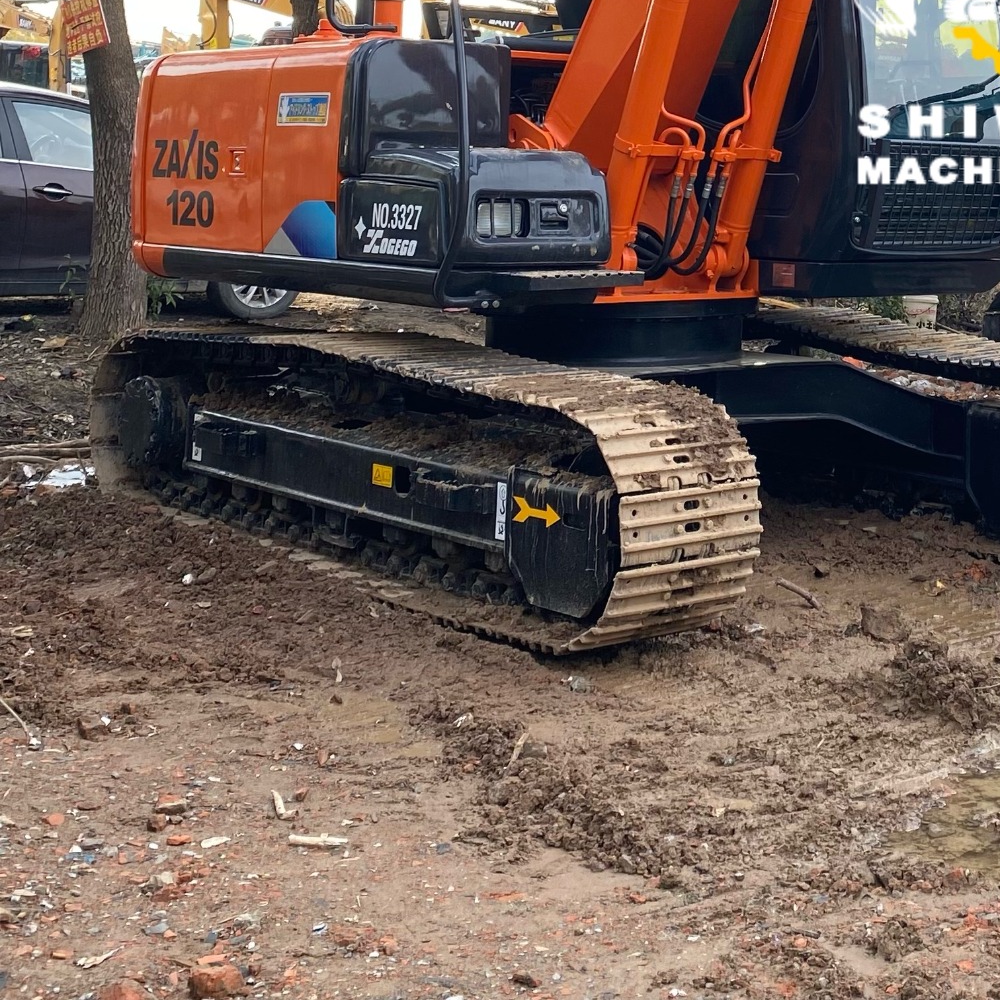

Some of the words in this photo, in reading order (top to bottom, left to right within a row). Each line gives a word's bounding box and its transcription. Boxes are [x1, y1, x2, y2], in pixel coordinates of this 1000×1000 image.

[152, 129, 219, 180] ZAXIS
[166, 189, 215, 228] 120
[371, 202, 423, 231] NO.3327
